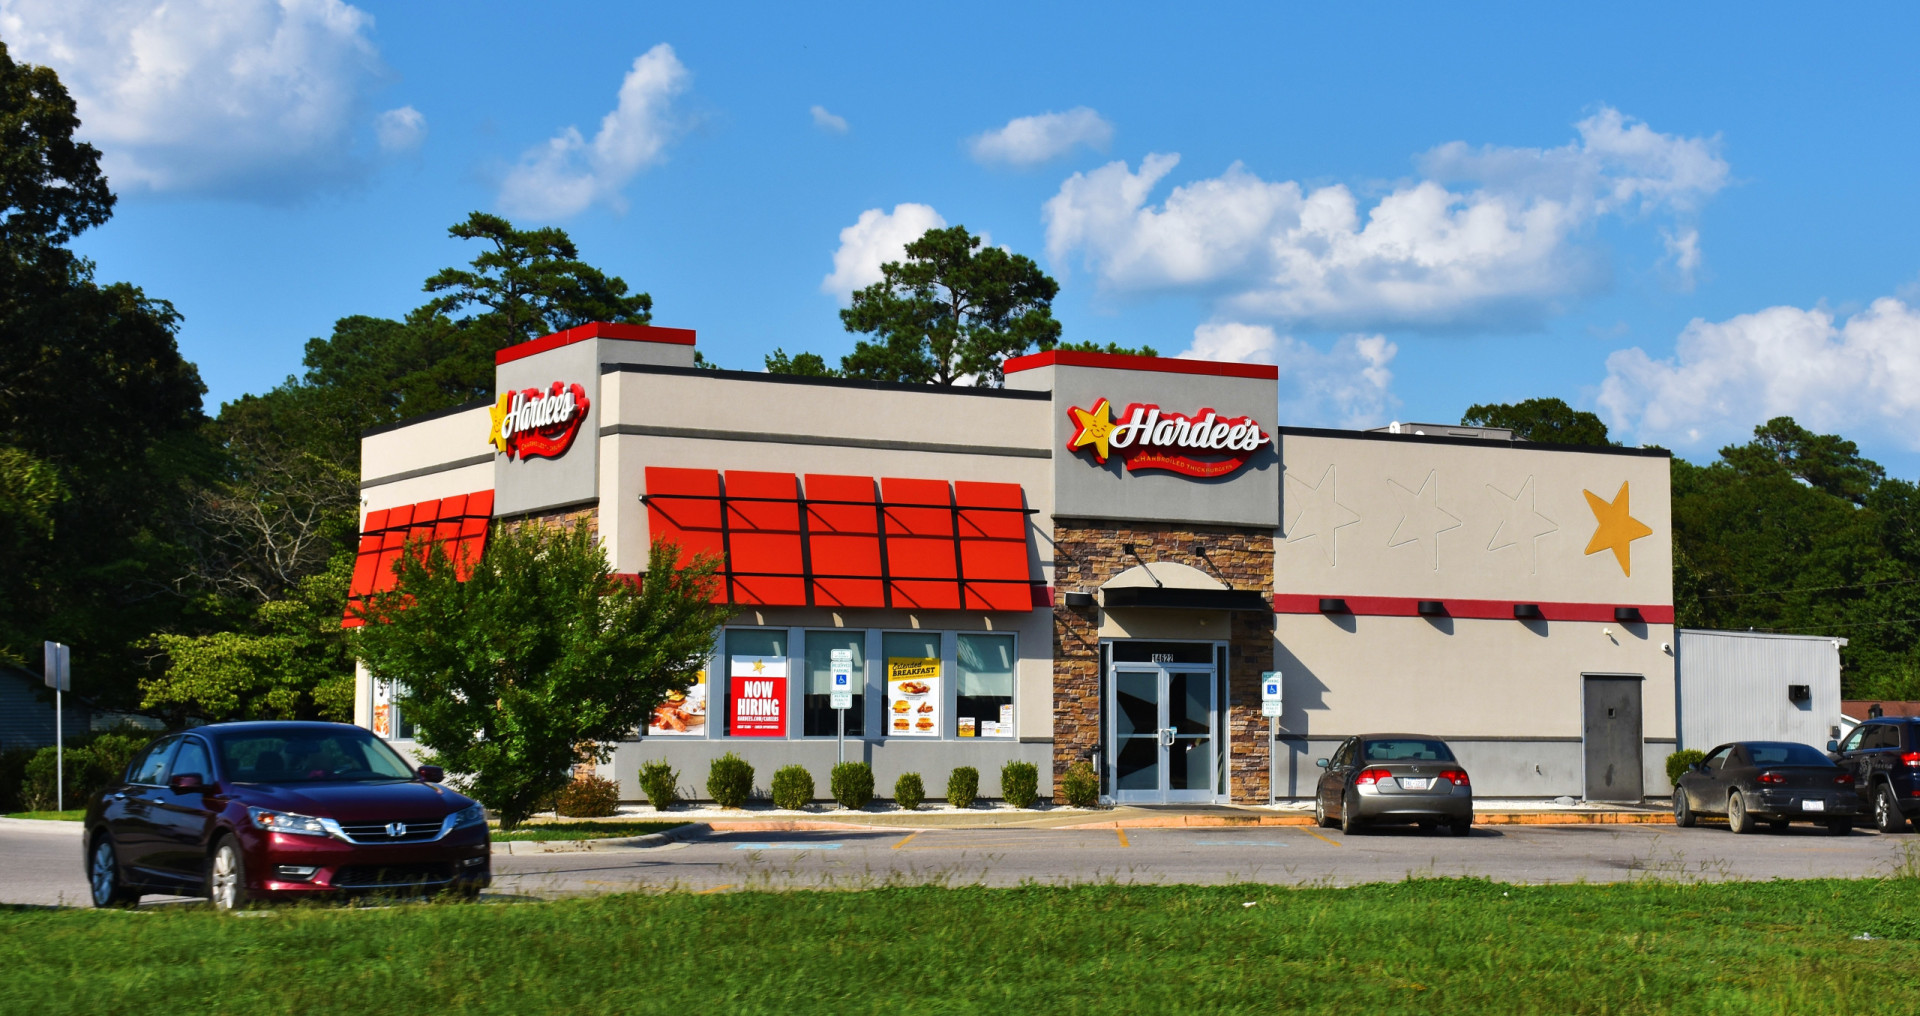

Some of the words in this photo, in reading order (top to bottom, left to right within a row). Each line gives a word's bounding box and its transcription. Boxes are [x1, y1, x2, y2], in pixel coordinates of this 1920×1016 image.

[501, 387, 576, 439] Hardee's
[1109, 408, 1270, 450] Hardee's
[892, 667, 935, 676] BREAKFAST
[744, 681, 773, 698] NOW
[737, 699, 779, 715] HIRING
